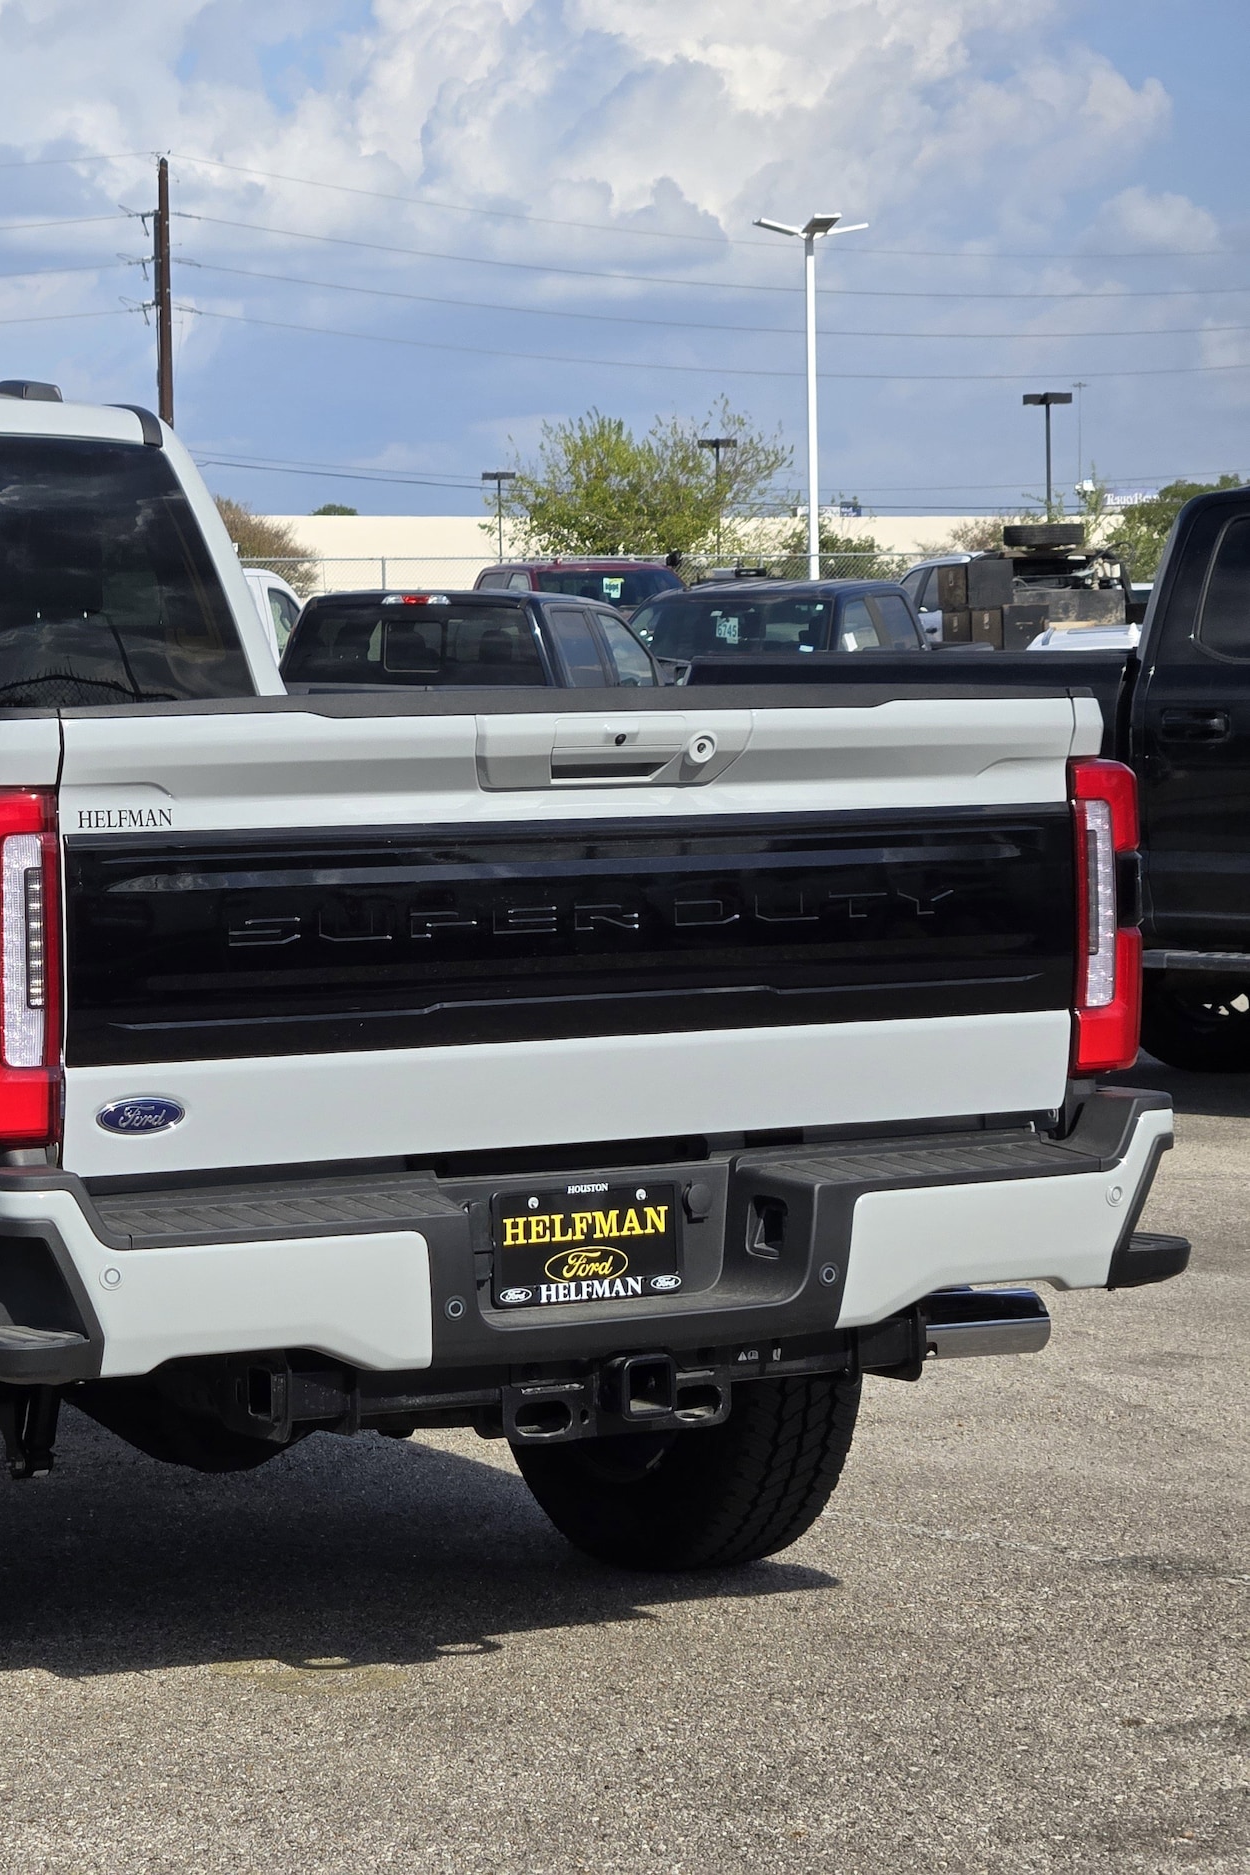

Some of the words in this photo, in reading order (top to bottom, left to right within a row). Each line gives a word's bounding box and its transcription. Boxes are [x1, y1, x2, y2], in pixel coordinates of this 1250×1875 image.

[717, 623, 737, 638] 6745
[77, 808, 173, 829] HELFMAN
[228, 905, 641, 947] SUPER
[674, 888, 955, 928] DUTY
[118, 1104, 167, 1128] Ford
[567, 1182, 609, 1195] HOUSTON
[502, 1205, 669, 1246] HELFMAN
[562, 1250, 615, 1279] Ford
[539, 1275, 645, 1304] HELFMAN
